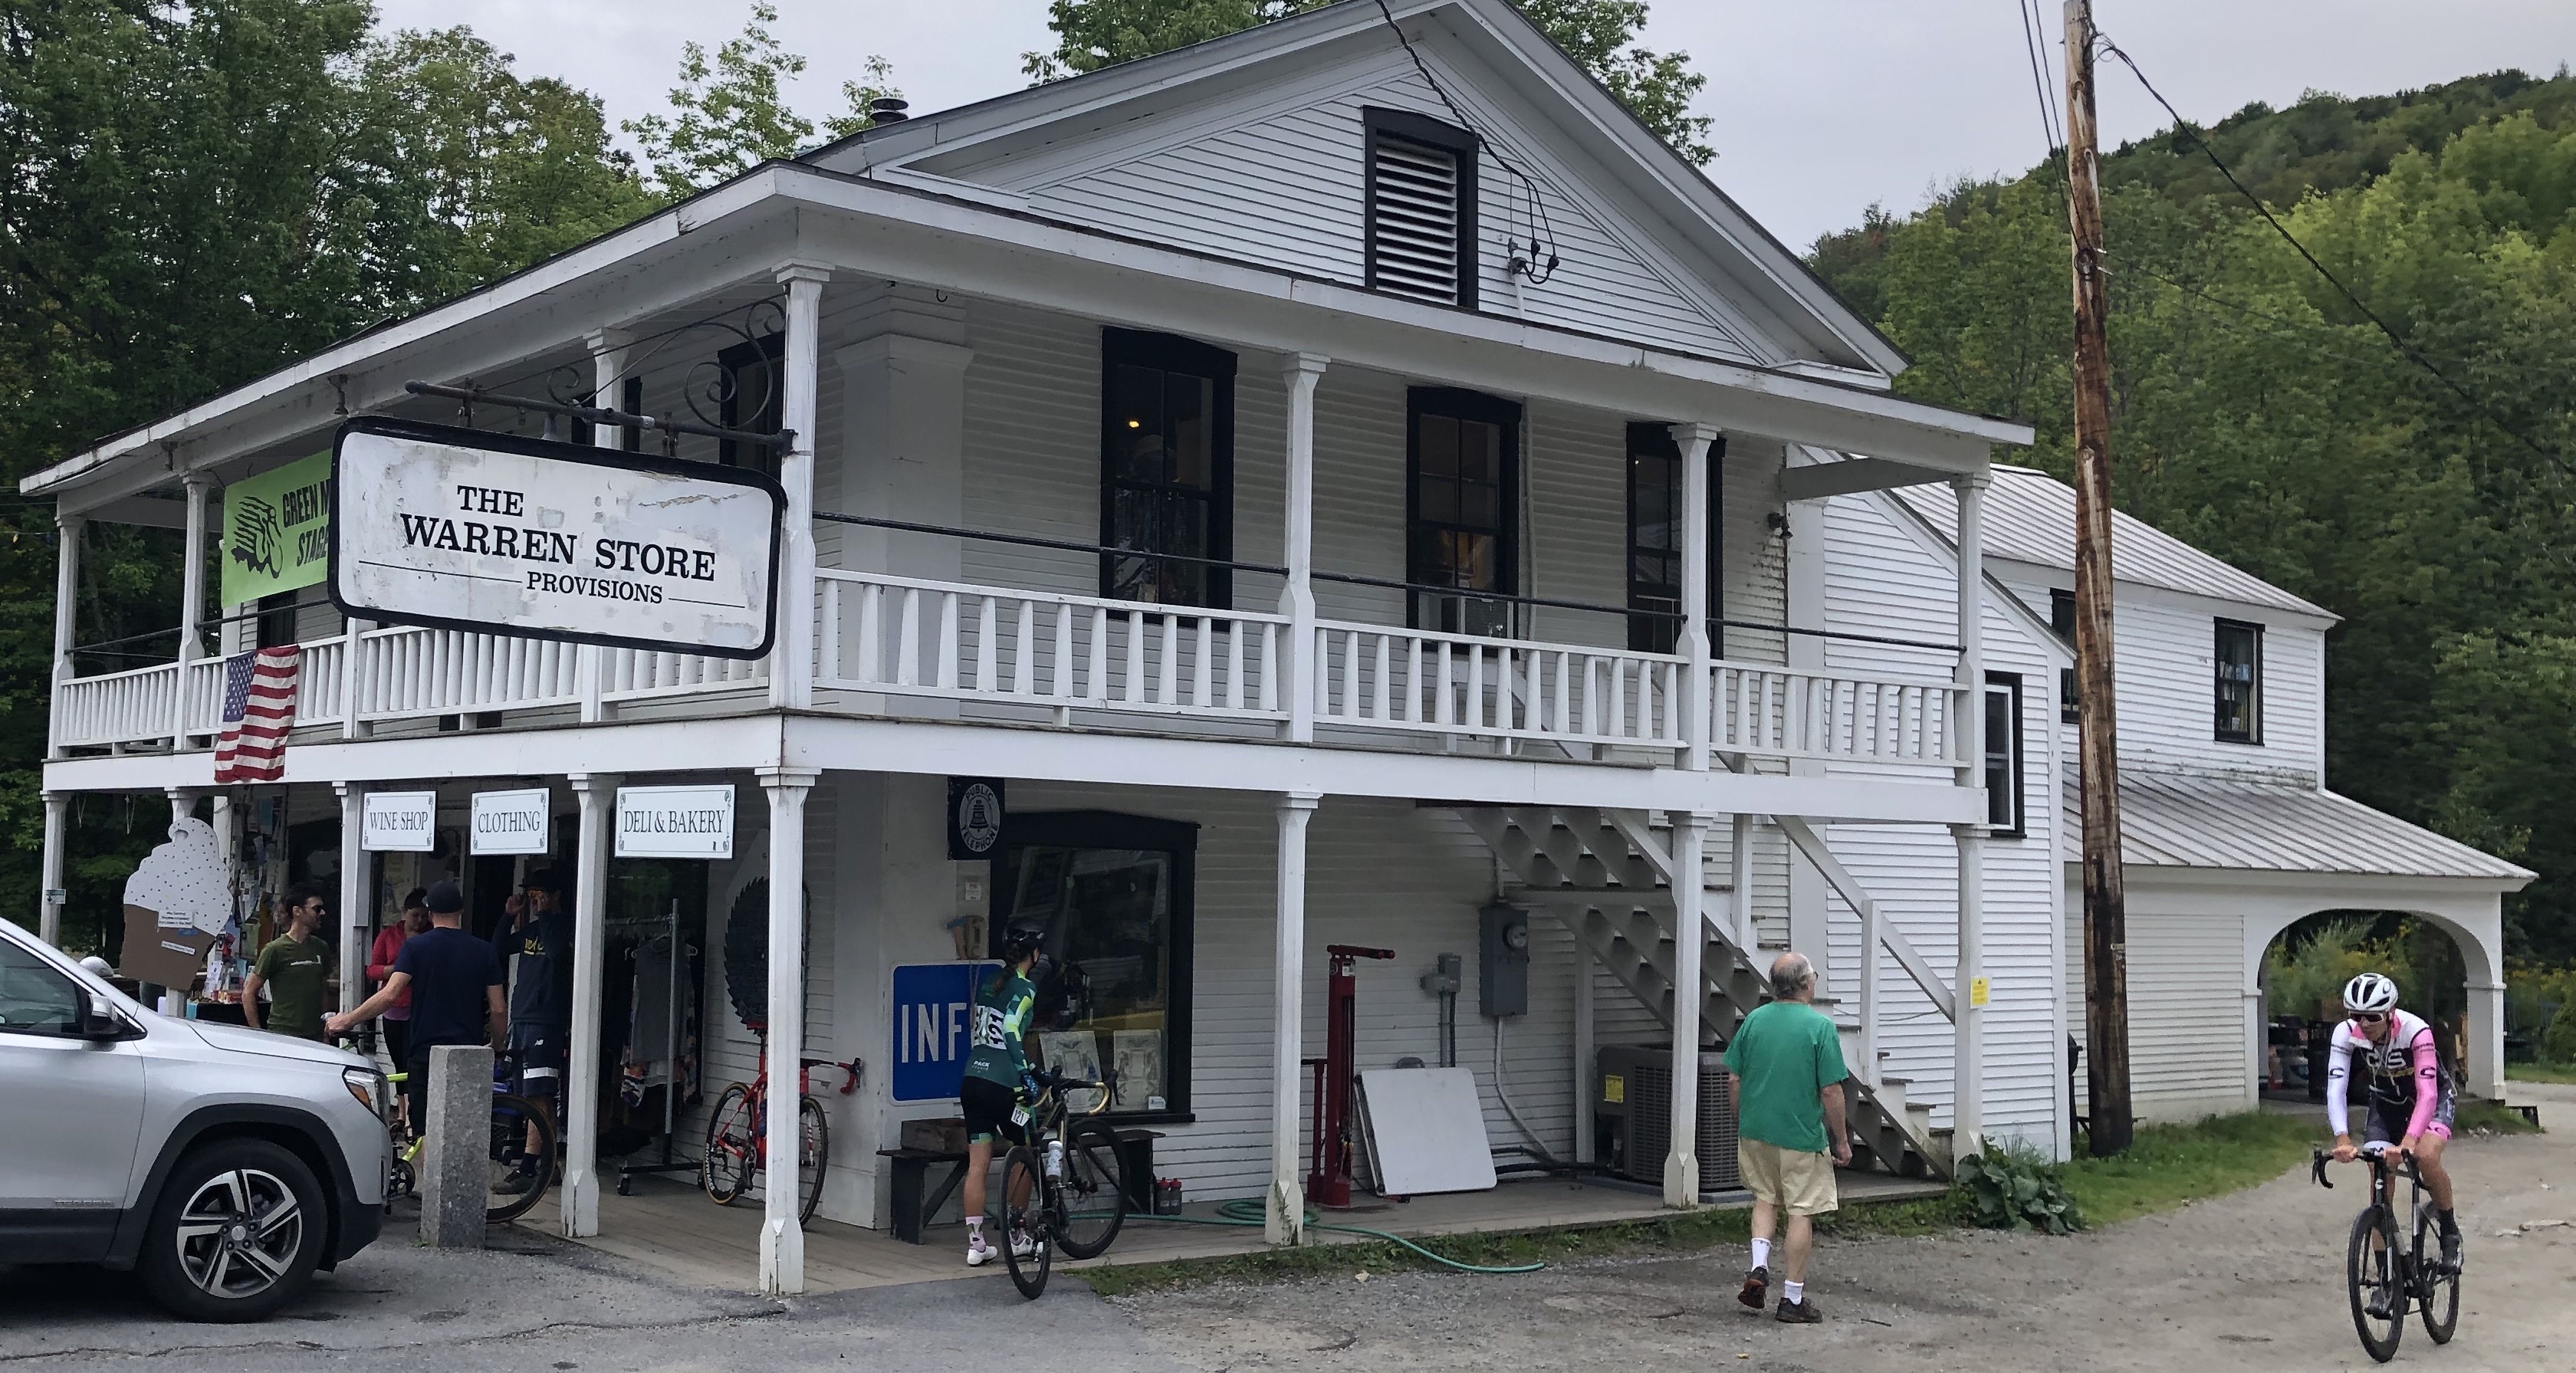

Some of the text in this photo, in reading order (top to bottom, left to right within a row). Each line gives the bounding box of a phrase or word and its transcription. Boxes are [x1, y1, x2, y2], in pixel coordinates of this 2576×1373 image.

[282, 484, 318, 528] GREEN
[457, 484, 524, 517] THE
[400, 514, 716, 581] WARREN STORE
[527, 571, 663, 604] PROVISIONS
[966, 785, 994, 801] PUBLIC
[370, 811, 429, 830] WINE SHOP
[478, 810, 540, 833] CLOTHING
[624, 810, 725, 833] DELI & BAKERY
[961, 823, 998, 850] TELEPHONE
[902, 1003, 967, 1063] INF
[988, 1013, 1004, 1044] 121
[1013, 1109, 1024, 1123] 121
